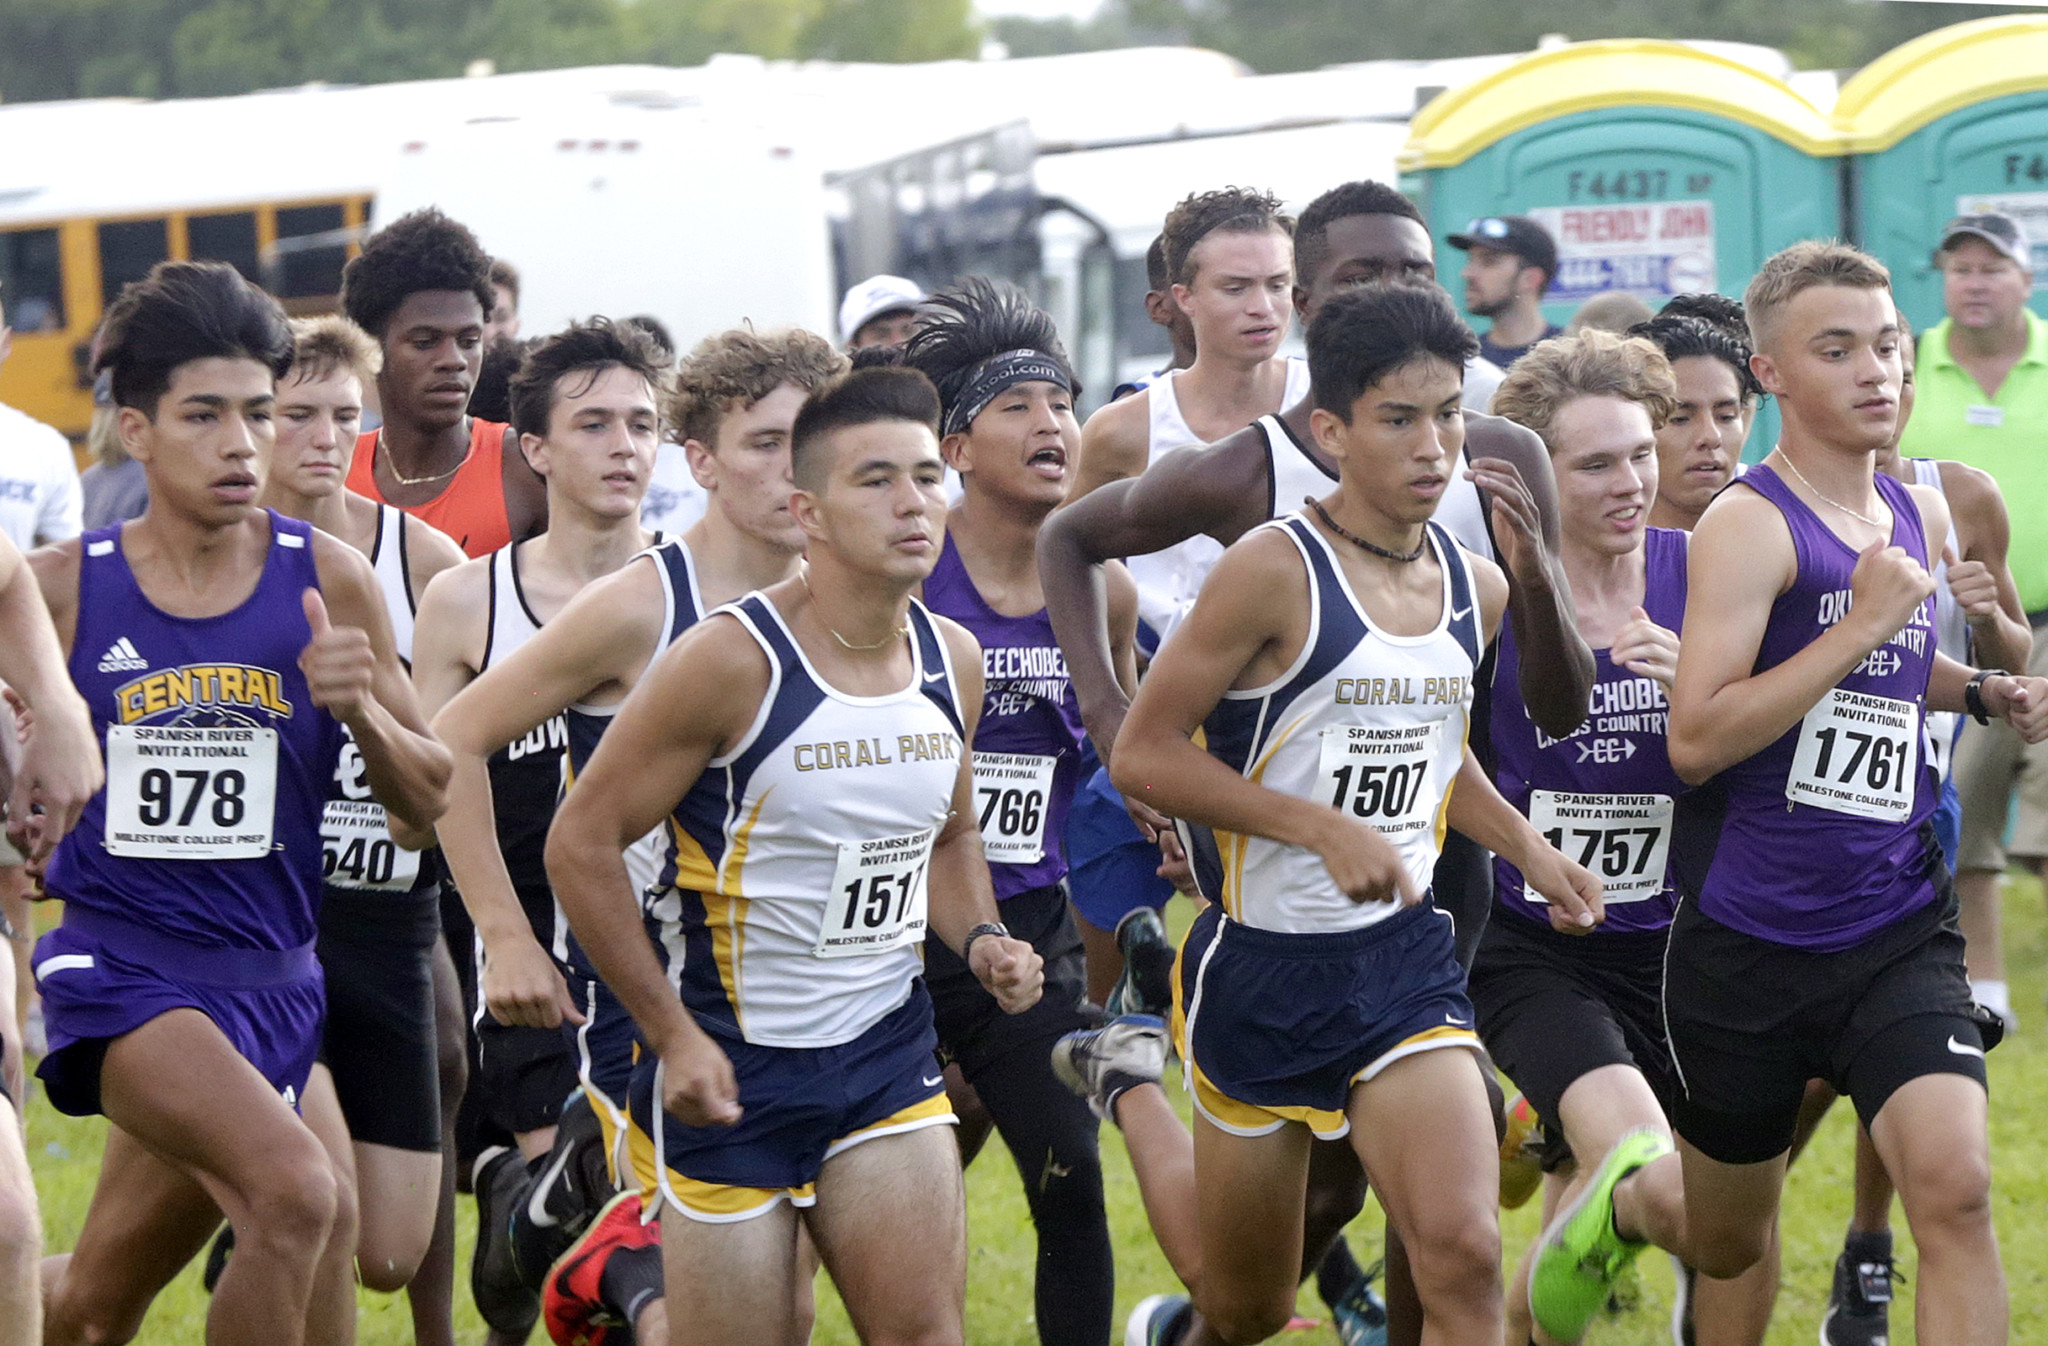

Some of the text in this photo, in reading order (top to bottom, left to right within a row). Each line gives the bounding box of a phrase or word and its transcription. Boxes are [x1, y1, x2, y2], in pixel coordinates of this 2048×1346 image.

[1563, 207, 1707, 243] FRIENDLY JOHN
[98, 658, 149, 673] adidas
[983, 646, 1070, 679] EECHOBE
[115, 663, 293, 724] CENTRAL
[1009, 680, 1068, 705] COUNTRY
[1335, 676, 1471, 705] CORAL PARK
[1833, 692, 1911, 715] SPANISH RIVER
[1833, 706, 1908, 729] INVITATIONAL
[134, 729, 254, 742] SPANISH RIVER
[508, 712, 568, 761] COW
[1348, 726, 1430, 740] SPANISH RIVER
[138, 744, 249, 757] INVITATIONAL
[794, 732, 956, 771] CORAL PARK
[1348, 741, 1424, 754] INVITATIONAL
[973, 753, 1042, 768] PANISH RIVER
[1814, 727, 1909, 794] 1761
[973, 767, 1038, 780] NVITATIONAL
[139, 767, 246, 828] 978
[1332, 759, 1429, 818] 1507
[1795, 782, 1854, 801] MILESTONE
[1856, 793, 1889, 808] COLLEGE
[1889, 797, 1908, 811] PREP
[1553, 793, 1656, 806] SPANISH RIVER
[1556, 807, 1651, 819] INVITATIONAL
[1405, 820, 1428, 831] PREP
[114, 832, 266, 845] MILESTONE COLLEGE PREP
[860, 837, 910, 853] SPANISH
[1543, 826, 1662, 878] 1757
[1636, 879, 1658, 889] PREP
[825, 934, 877, 946] MILESTONE
